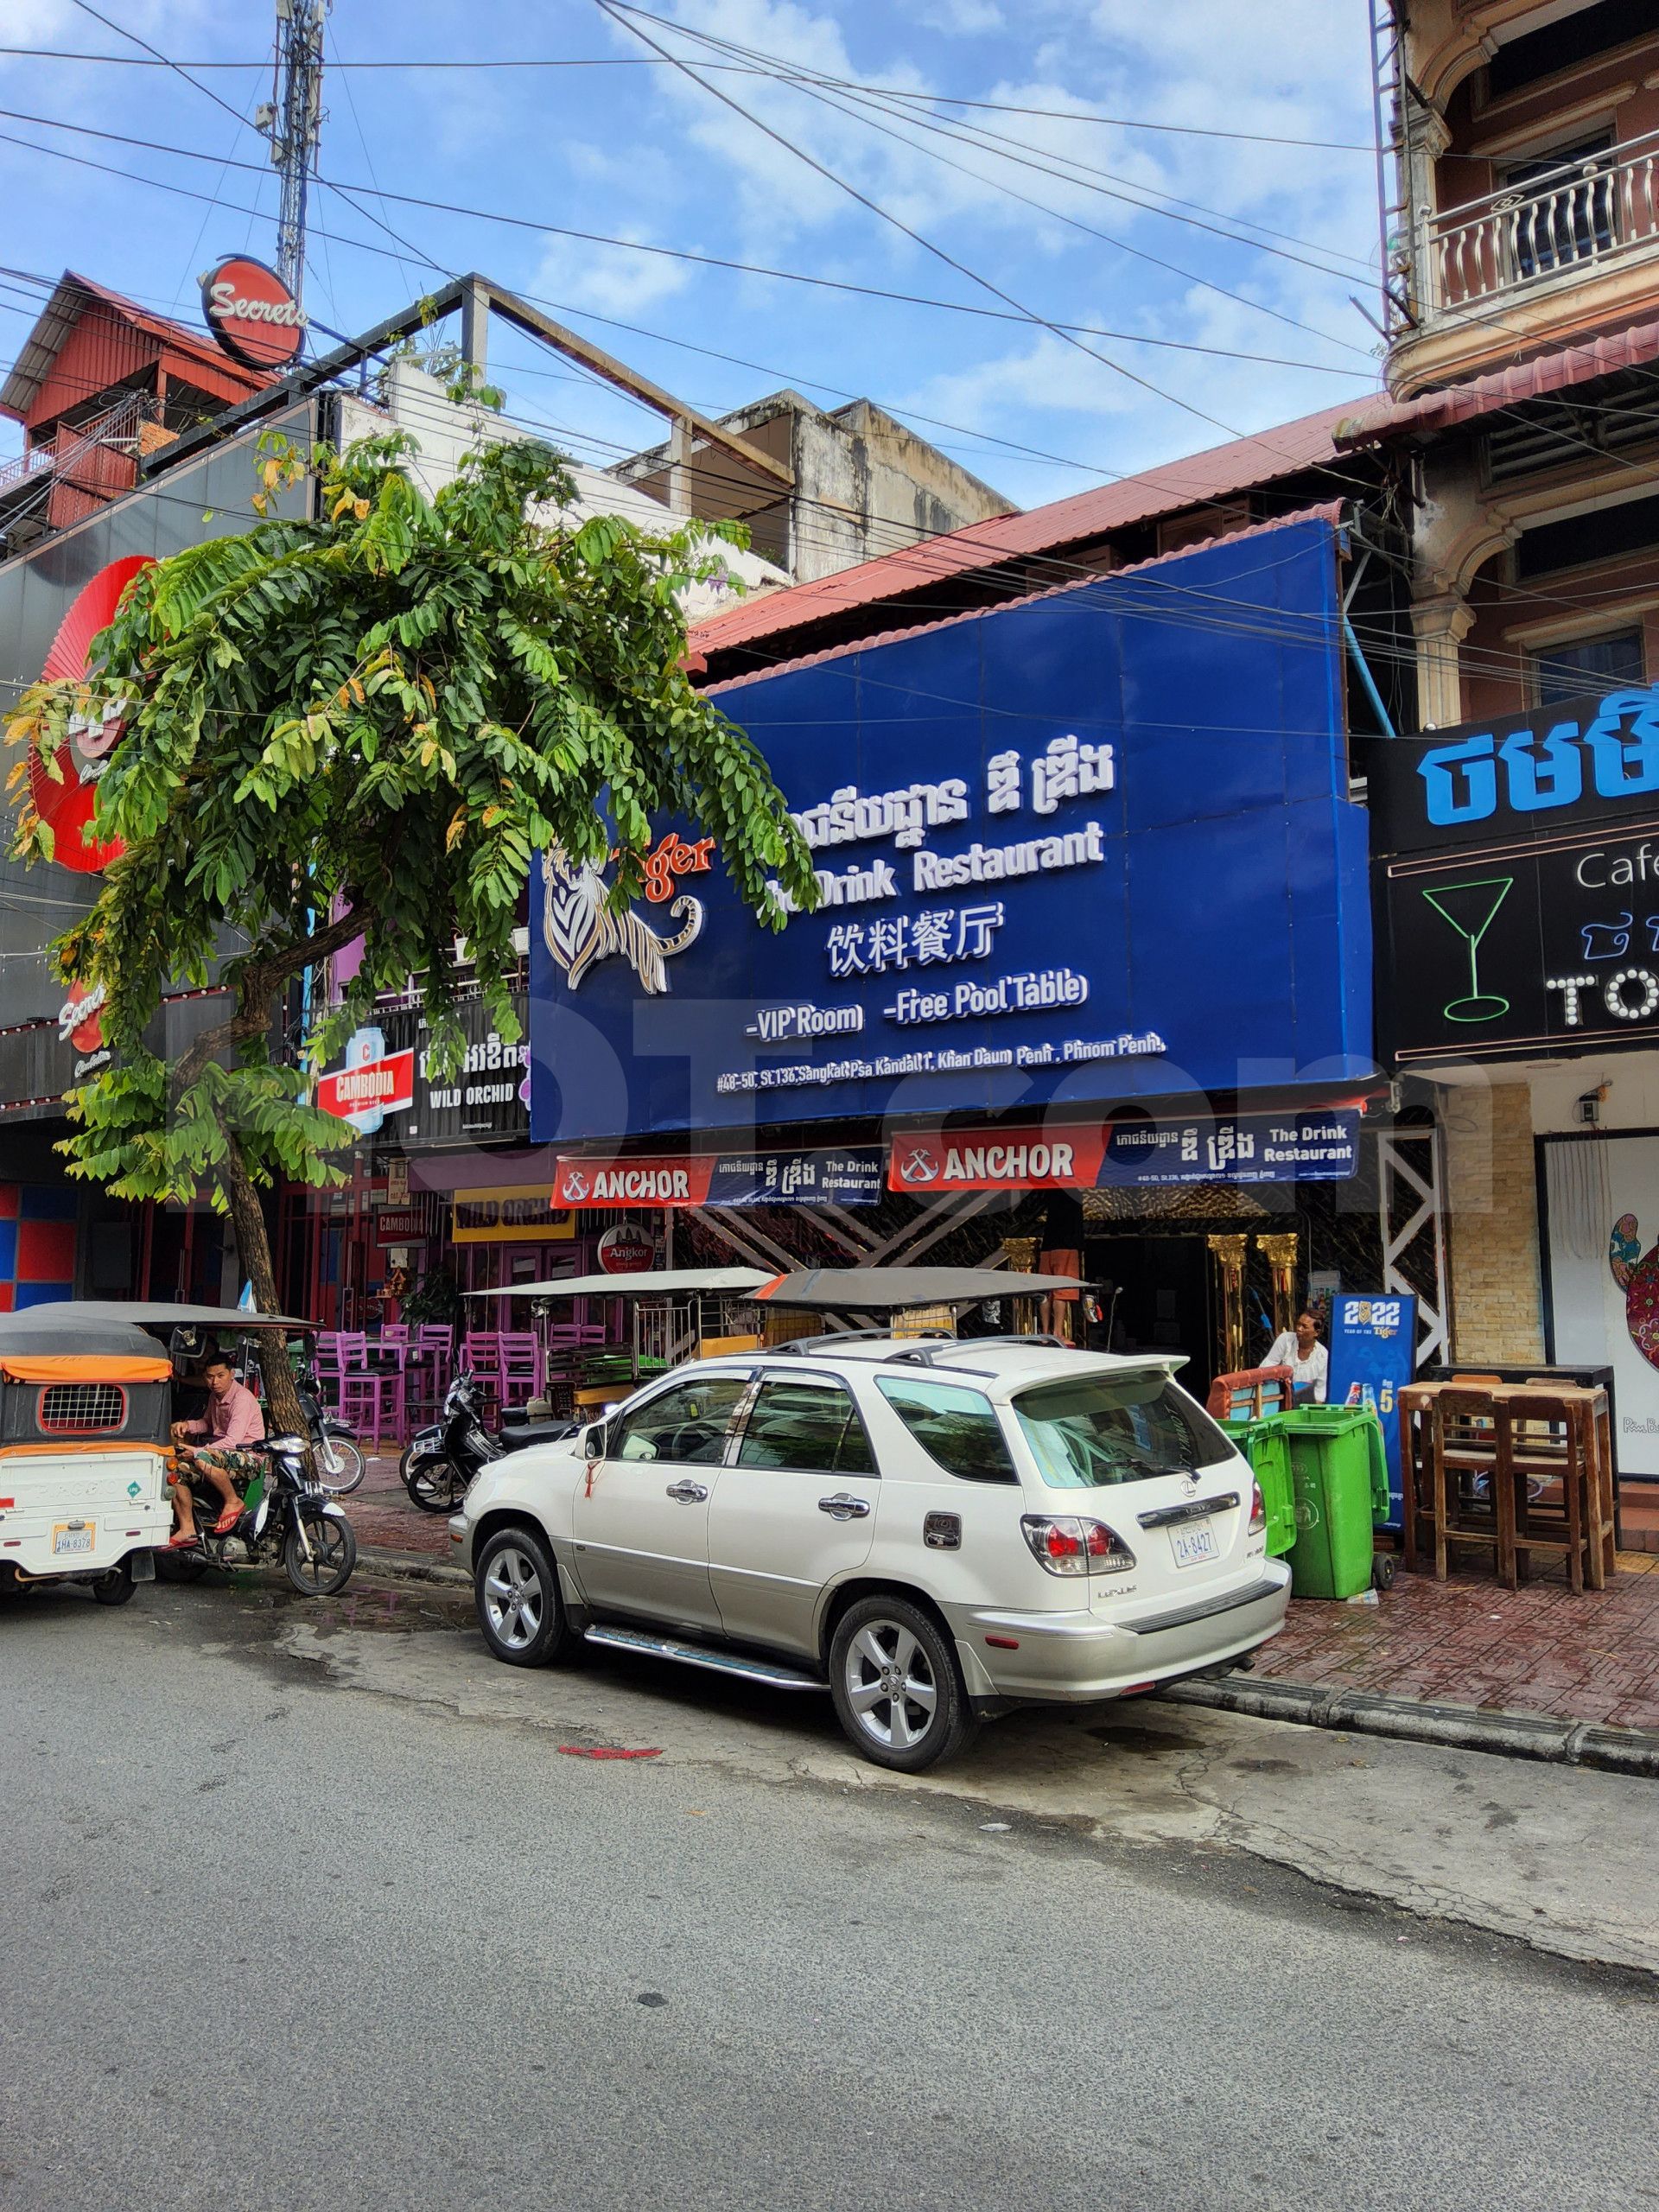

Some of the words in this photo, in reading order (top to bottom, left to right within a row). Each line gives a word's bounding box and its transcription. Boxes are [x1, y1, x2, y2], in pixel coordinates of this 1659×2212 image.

[209, 283, 309, 327] Secrets
[914, 822, 1104, 892] Restaurant
[826, 901, 1005, 978] 饮料餐厅
[955, 976, 1008, 1016] Pool
[1546, 968, 1659, 1026] TO
[938, 1049, 971, 1070] Khan
[1064, 1039, 1115, 1061] Phnom
[336, 1071, 394, 1103] CAMBODIA
[429, 1088, 461, 1109] WILD
[466, 1083, 515, 1105] ORCHID
[1269, 1128, 1298, 1143] The
[1301, 1126, 1347, 1142] Drink
[825, 1160, 845, 1173] The
[847, 1160, 878, 1173] Drink
[944, 1143, 1073, 1180] ANCHOR
[1263, 1146, 1352, 1162] Restaurant
[593, 1170, 690, 1200] ANCHOR
[822, 1177, 880, 1189] Restaurant
[610, 1247, 648, 1260] Angkor
[1176, 1532, 1212, 1558] 2A-8427
